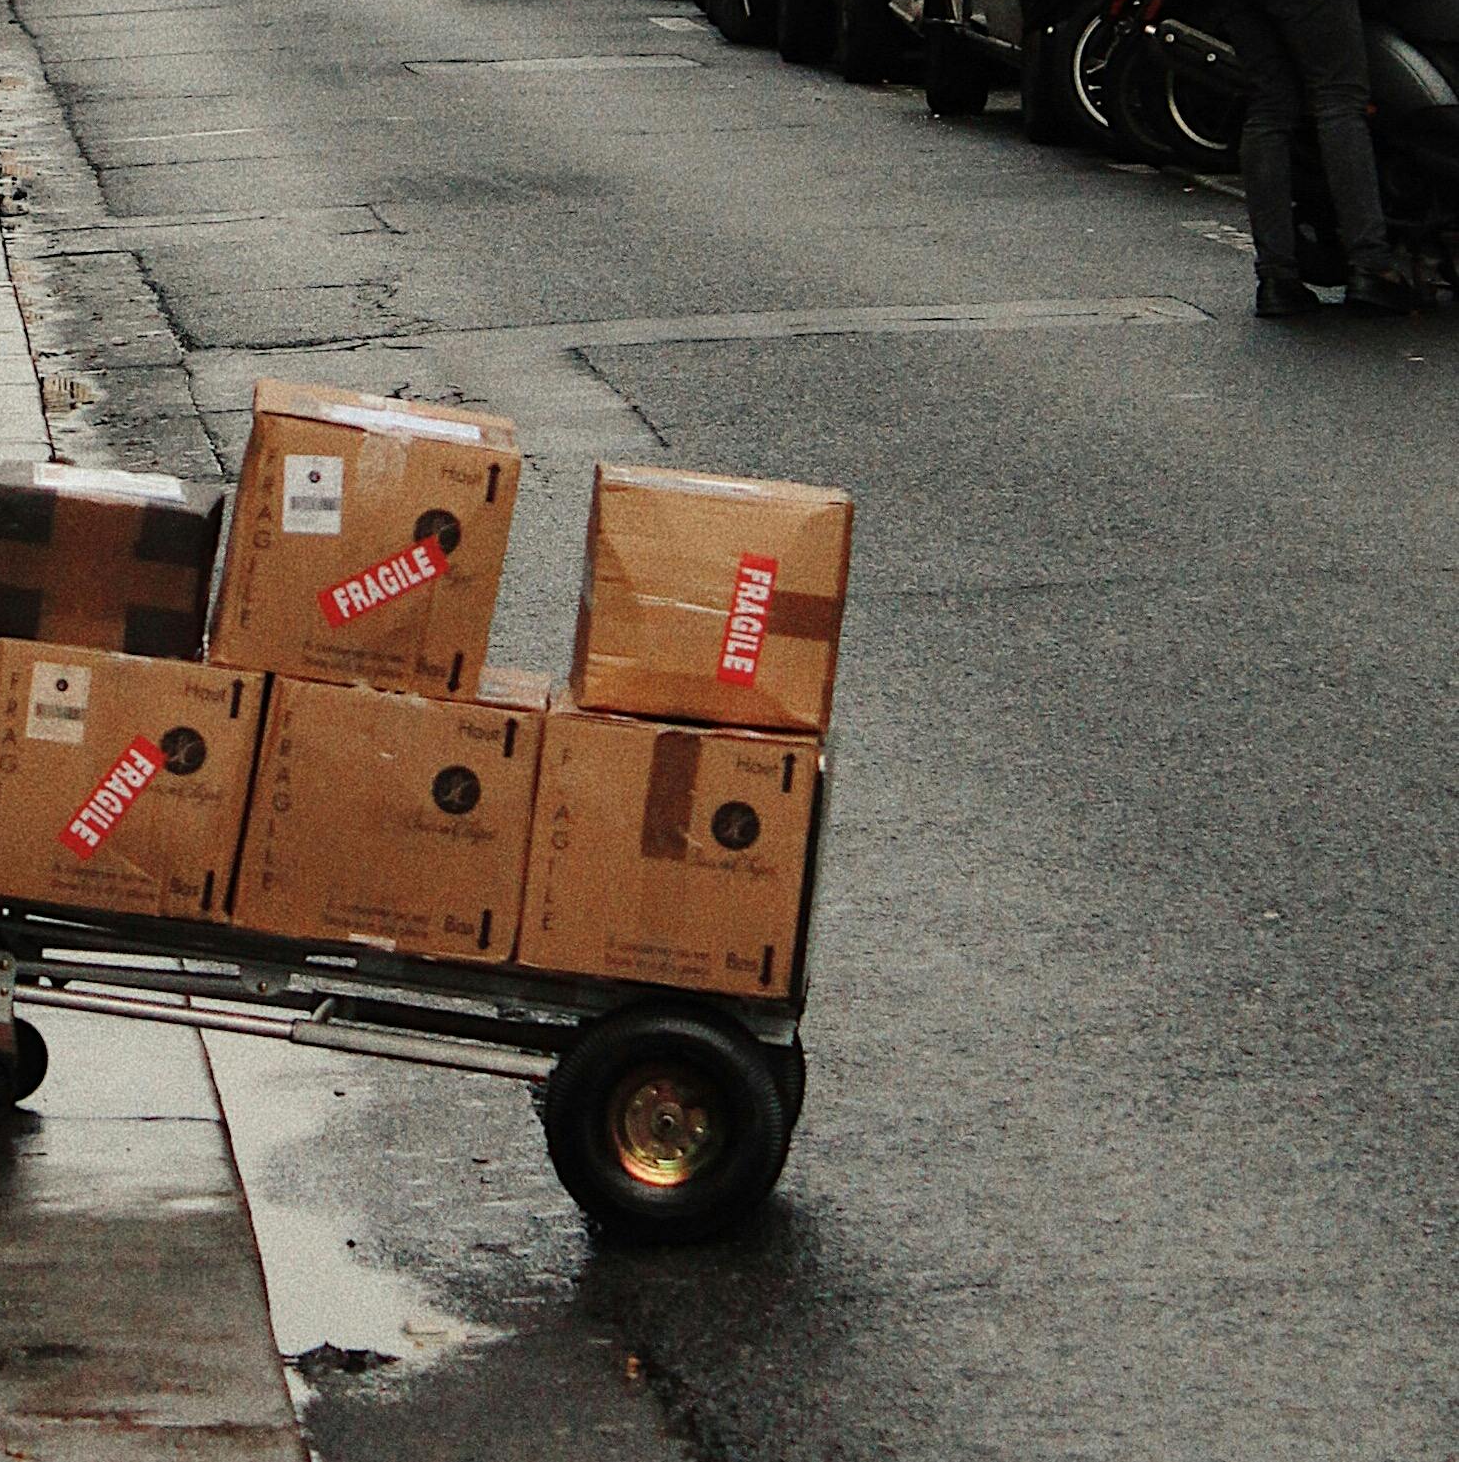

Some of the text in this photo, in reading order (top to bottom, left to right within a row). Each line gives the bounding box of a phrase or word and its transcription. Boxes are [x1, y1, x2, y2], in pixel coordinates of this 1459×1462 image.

[331, 545, 437, 619] FRAGILE
[722, 567, 773, 674] FRAGILE
[69, 748, 157, 848] FRAGILE
